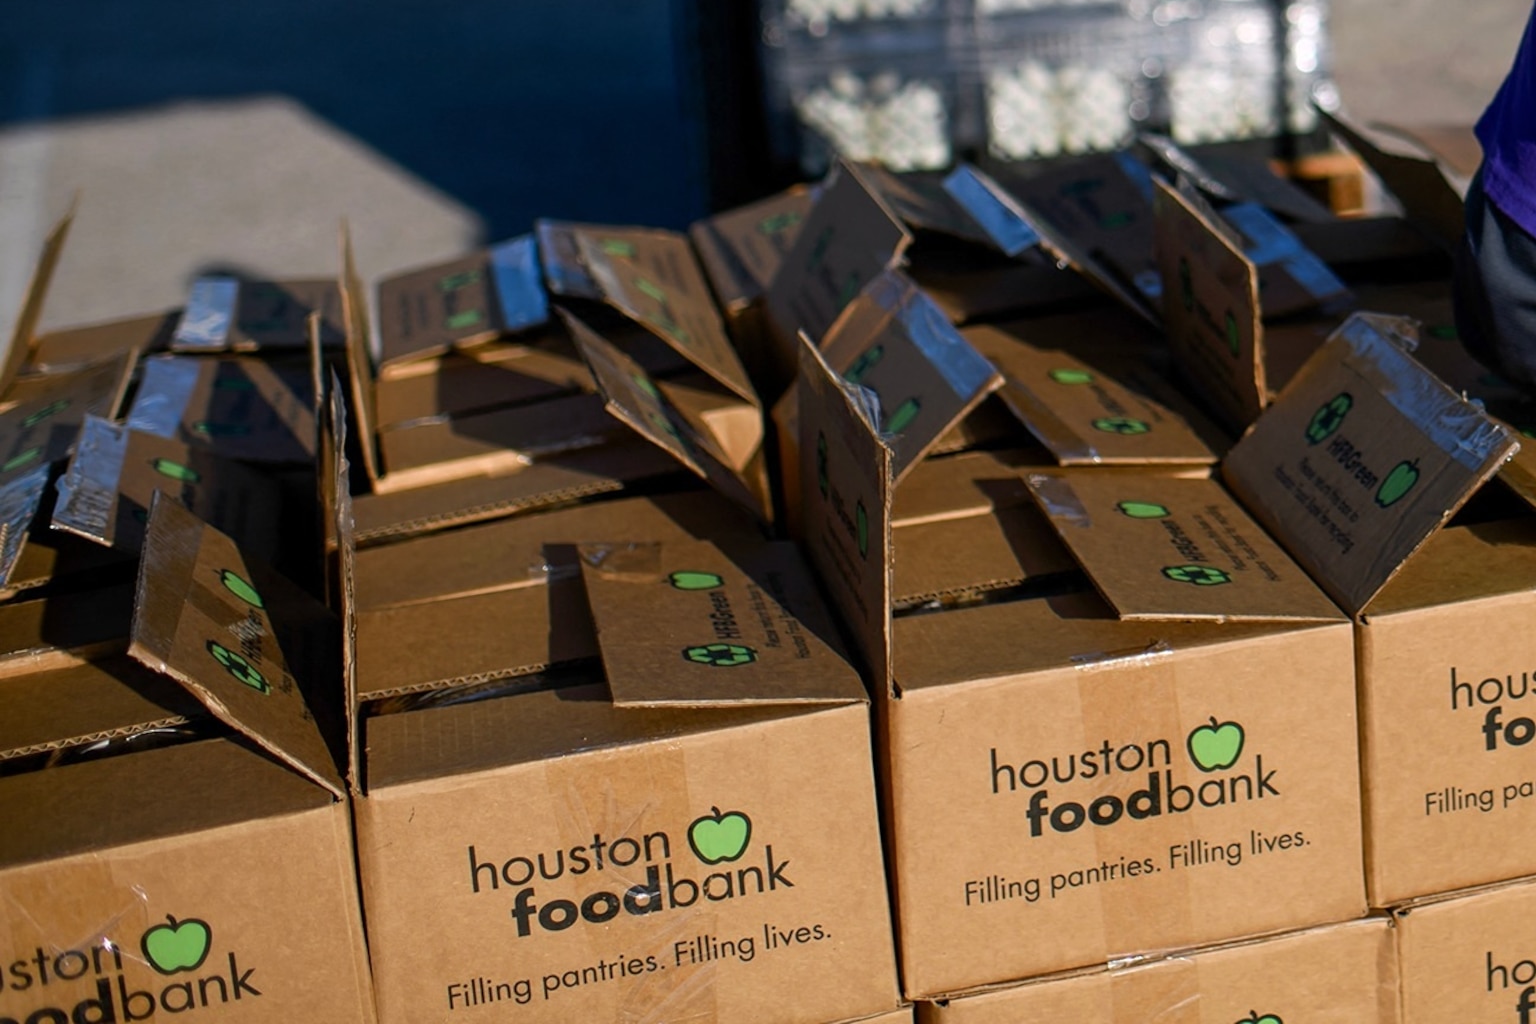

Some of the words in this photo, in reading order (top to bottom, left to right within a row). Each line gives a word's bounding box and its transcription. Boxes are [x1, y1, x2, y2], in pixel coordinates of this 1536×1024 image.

[989, 738, 1172, 794] houston
[1025, 753, 1281, 838] foodbank
[1424, 786, 1495, 816] Filling
[467, 830, 671, 894] houston
[511, 844, 796, 938] foodbank
[964, 874, 1041, 907] Filling
[1050, 855, 1162, 899] pantries.
[1168, 838, 1242, 870] Filling
[1249, 828, 1312, 856] lives.
[0, 940, 124, 995] ston
[446, 977, 533, 1011] Filling
[542, 954, 667, 1000] pantries.
[673, 934, 756, 968] Filling
[764, 921, 833, 951] lives.
